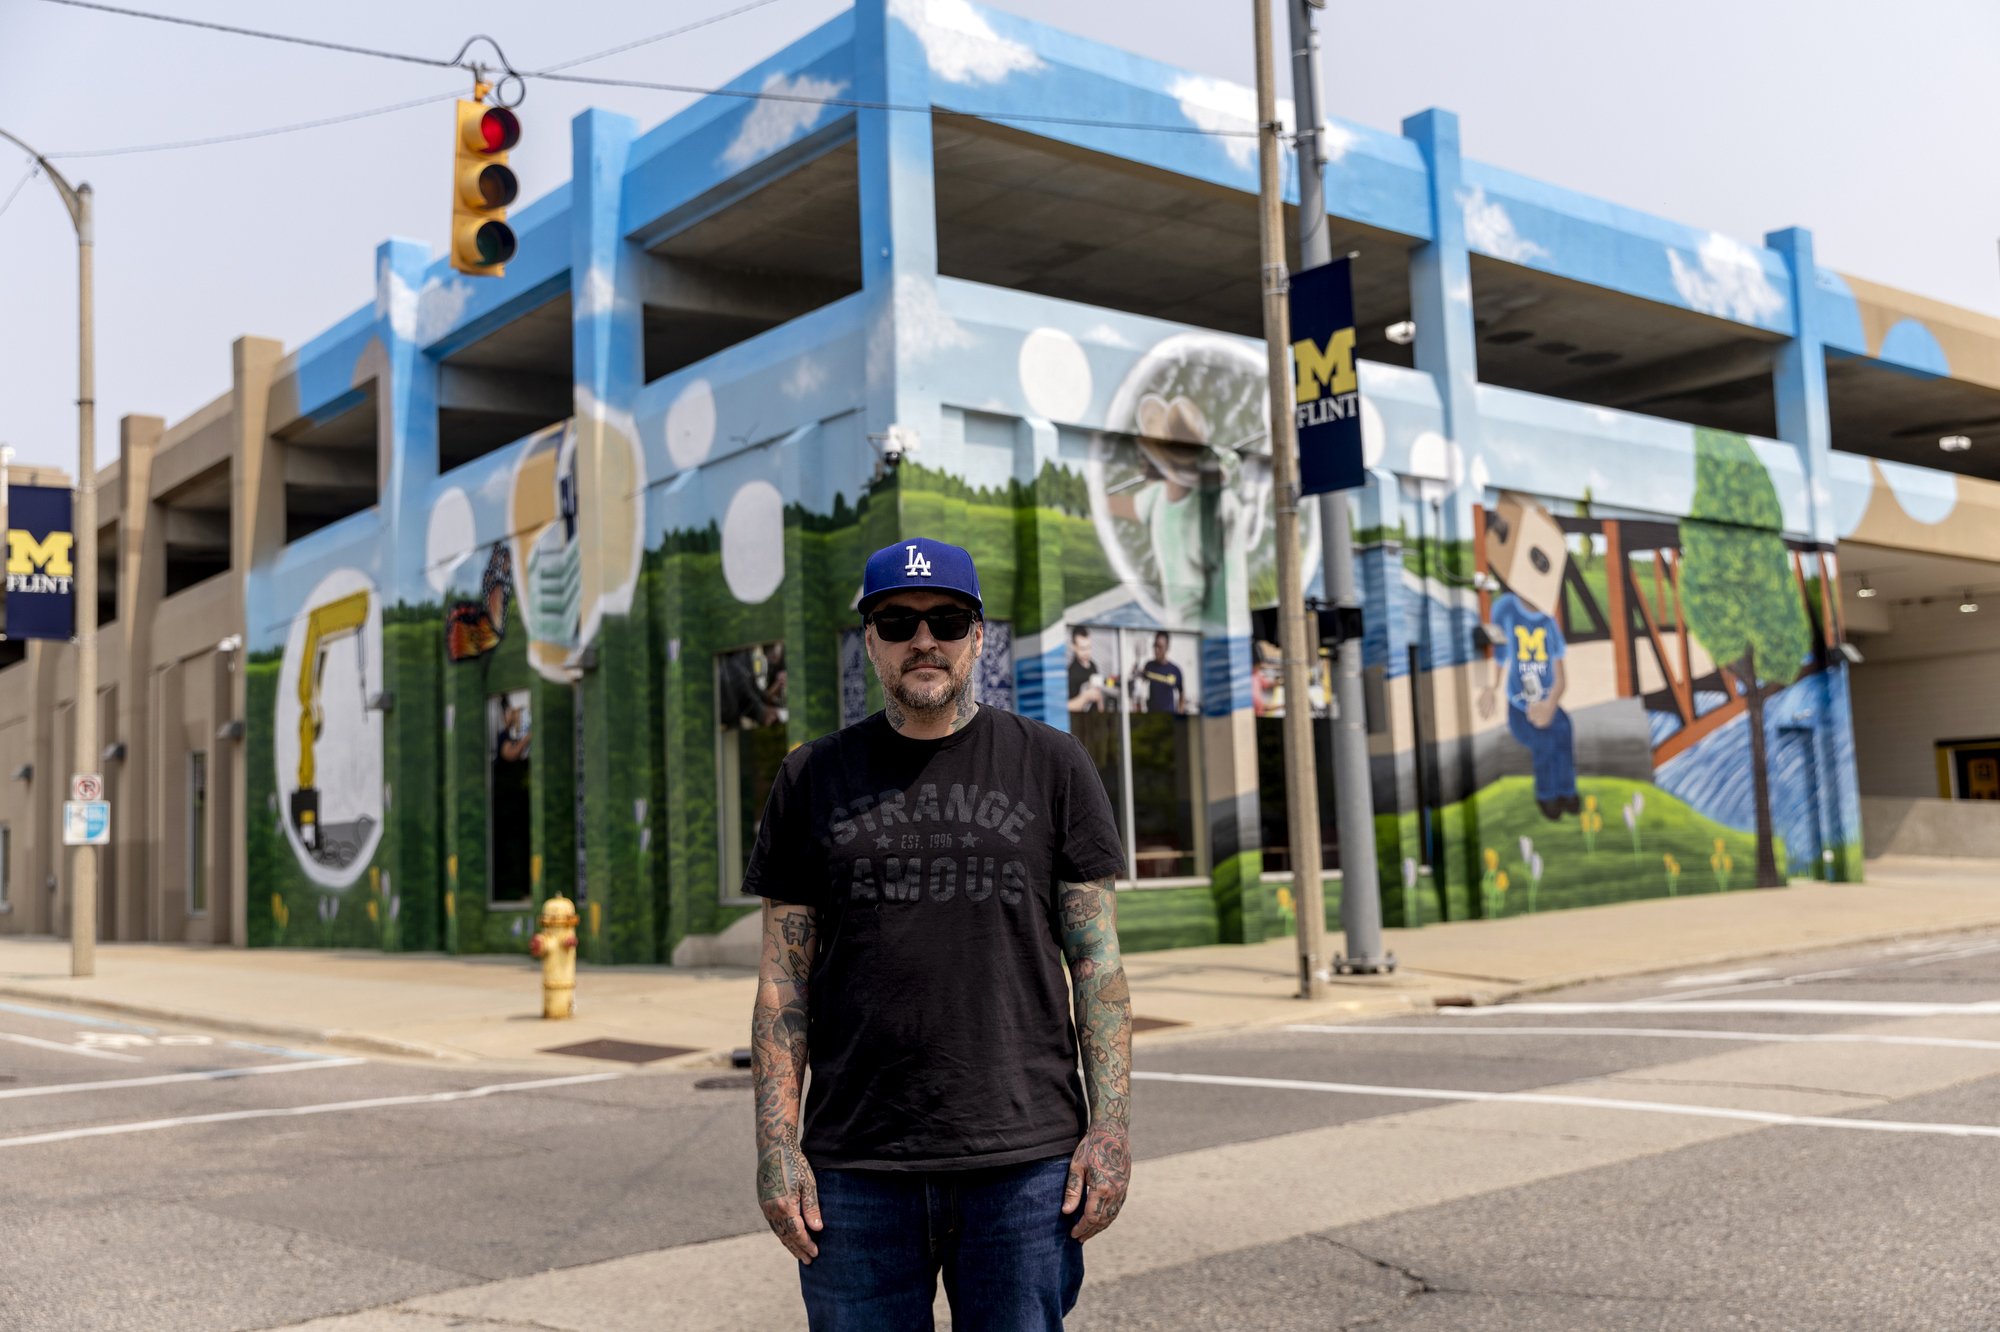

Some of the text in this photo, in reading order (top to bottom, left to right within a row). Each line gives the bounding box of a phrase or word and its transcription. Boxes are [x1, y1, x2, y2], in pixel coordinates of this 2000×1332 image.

[1294, 327, 1357, 403] M
[1297, 392, 1357, 429] FLINT
[7, 529, 73, 576] M
[905, 545, 931, 576] LA
[6, 573, 73, 594] FLINT
[1515, 626, 1548, 661] M
[828, 783, 1035, 845] STRANGE
[901, 833, 952, 849] EST. 1996
